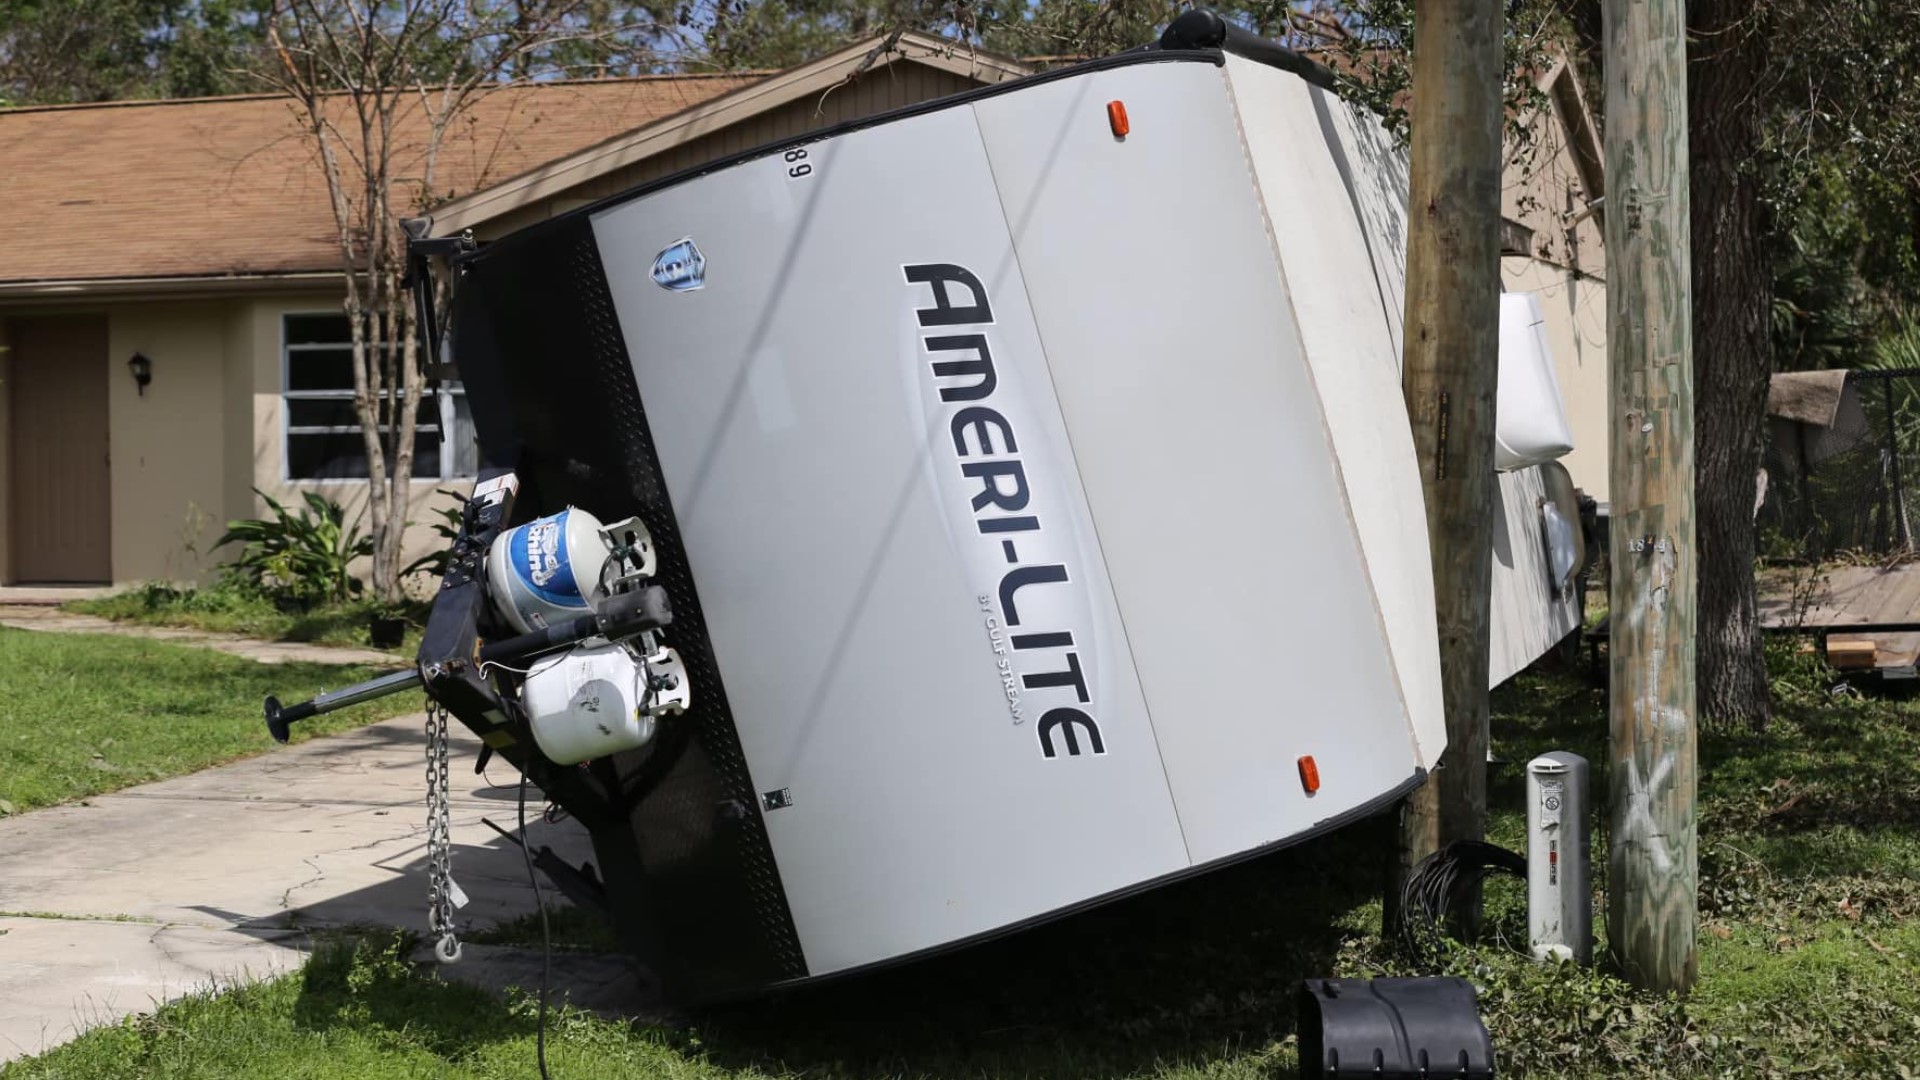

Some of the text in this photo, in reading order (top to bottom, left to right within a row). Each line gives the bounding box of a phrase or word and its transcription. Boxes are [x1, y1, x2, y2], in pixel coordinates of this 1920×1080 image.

[978, 595, 1024, 726] BY GULF STREAM
